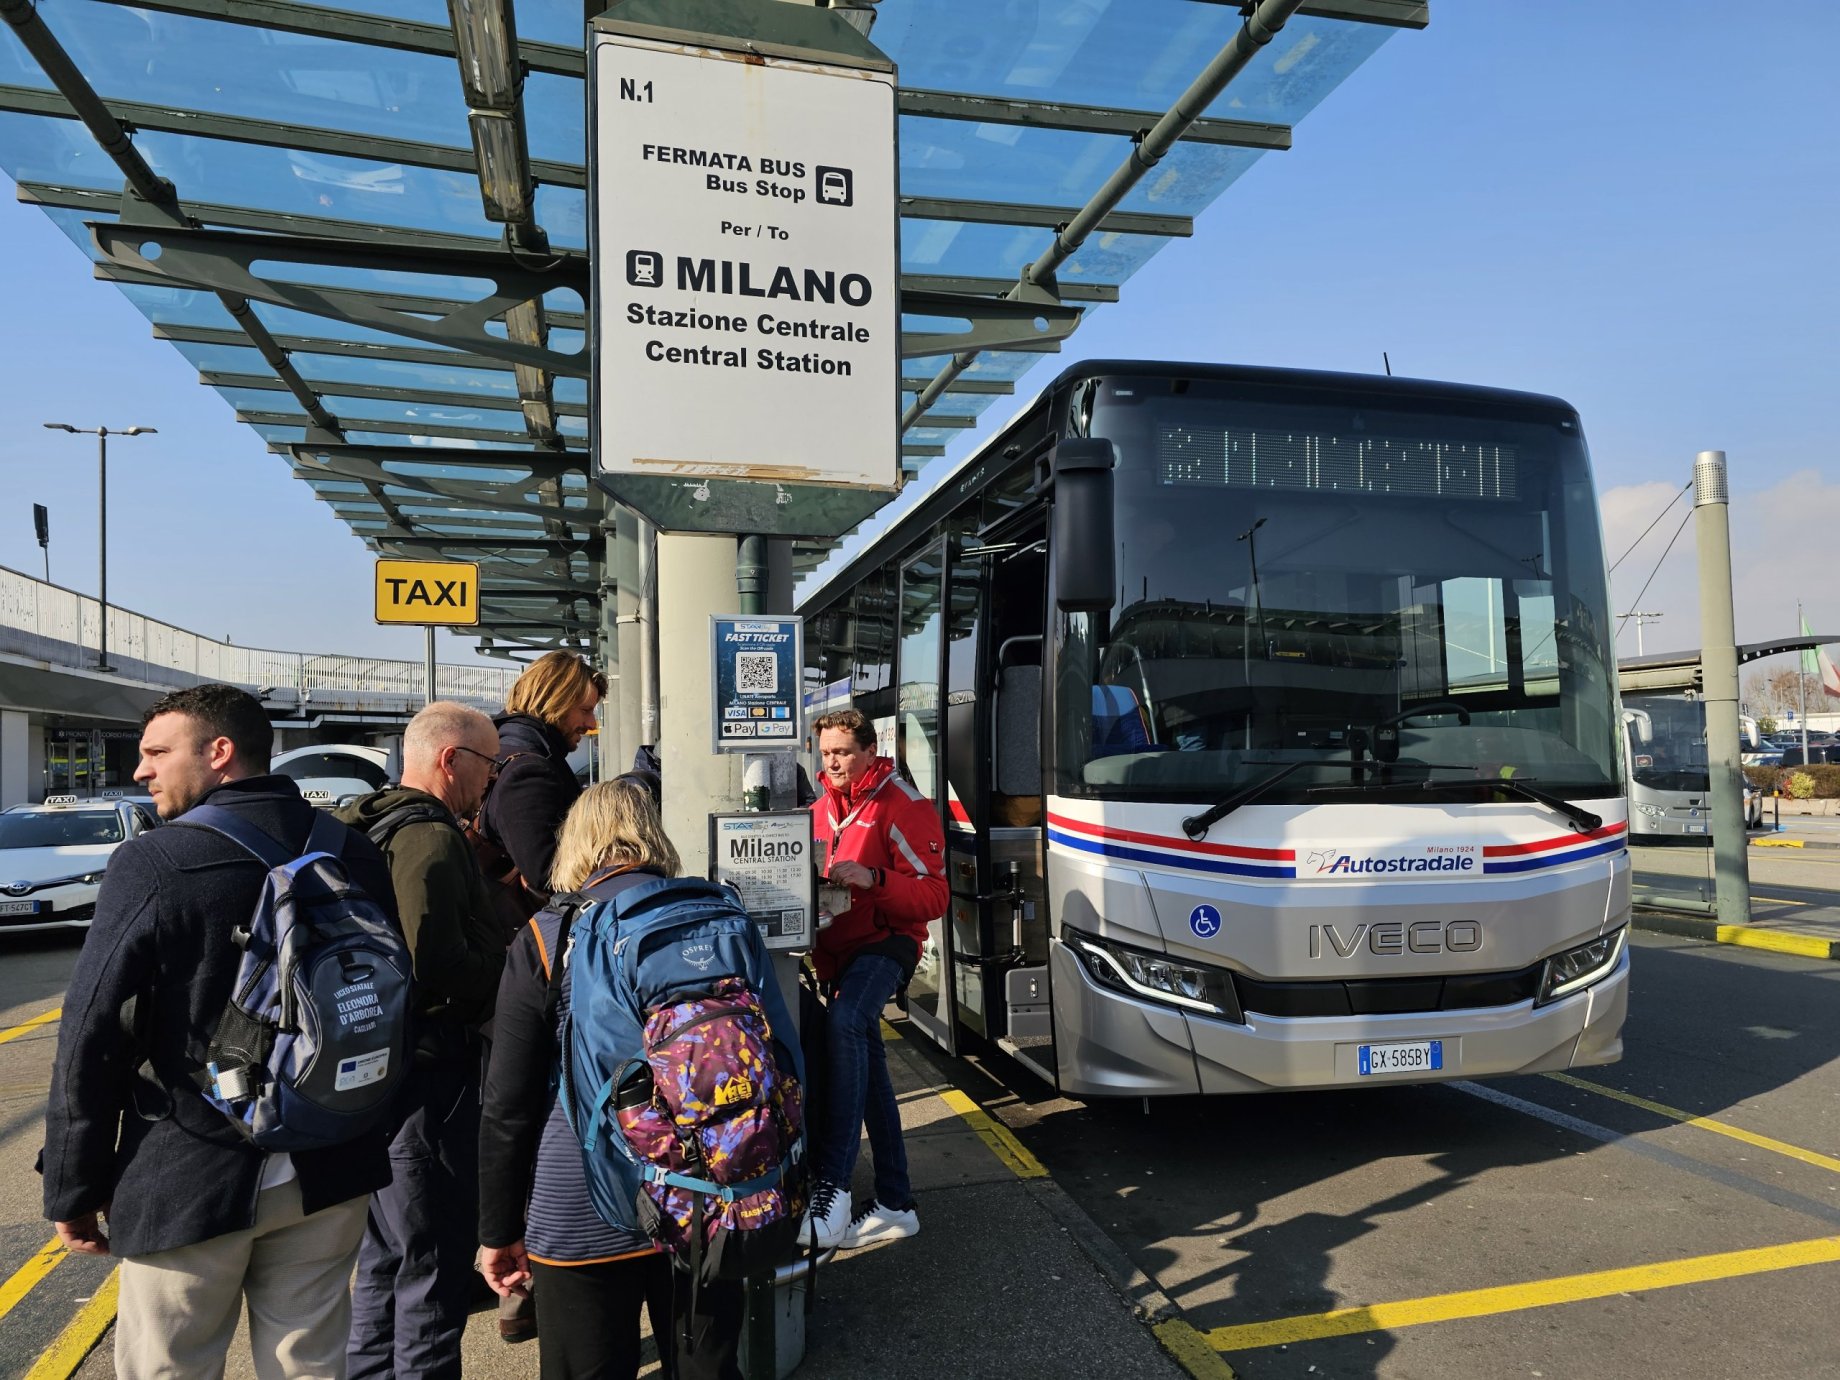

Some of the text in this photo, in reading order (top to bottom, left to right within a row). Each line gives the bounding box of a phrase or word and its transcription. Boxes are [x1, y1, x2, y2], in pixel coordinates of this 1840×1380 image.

[620, 77, 654, 103] N.1
[642, 144, 807, 178] FERMATA BUS
[706, 174, 807, 202] Bus Stop
[720, 220, 752, 237] Per
[767, 226, 790, 241] To
[676, 255, 873, 307] MILANO
[626, 302, 870, 344] Stazione Centrale
[645, 340, 852, 377] Central Station
[385, 578, 467, 607] TAXI
[725, 633, 790, 643] FAST TICKET
[728, 709, 746, 717] VISA
[734, 723, 756, 735] Pay
[772, 723, 791, 734] Pay
[50, 796, 74, 804] TAXI
[730, 838, 804, 858] Milano
[1426, 846, 1454, 854] Milano
[733, 855, 797, 865] CENTRAL STATION
[1328, 855, 1474, 874] Autostradale
[1309, 920, 1484, 959] IVECO
[682, 944, 714, 956] OSPREY
[333, 982, 374, 999] LICEO STATALE
[336, 993, 379, 1013] ELEONORA
[339, 1005, 384, 1025] D'ARBOREA
[1371, 1050, 1387, 1068] GX
[1392, 1048, 1430, 1067] 585BY
[728, 1081, 752, 1099] REI
[740, 1208, 763, 1218] FLASH
